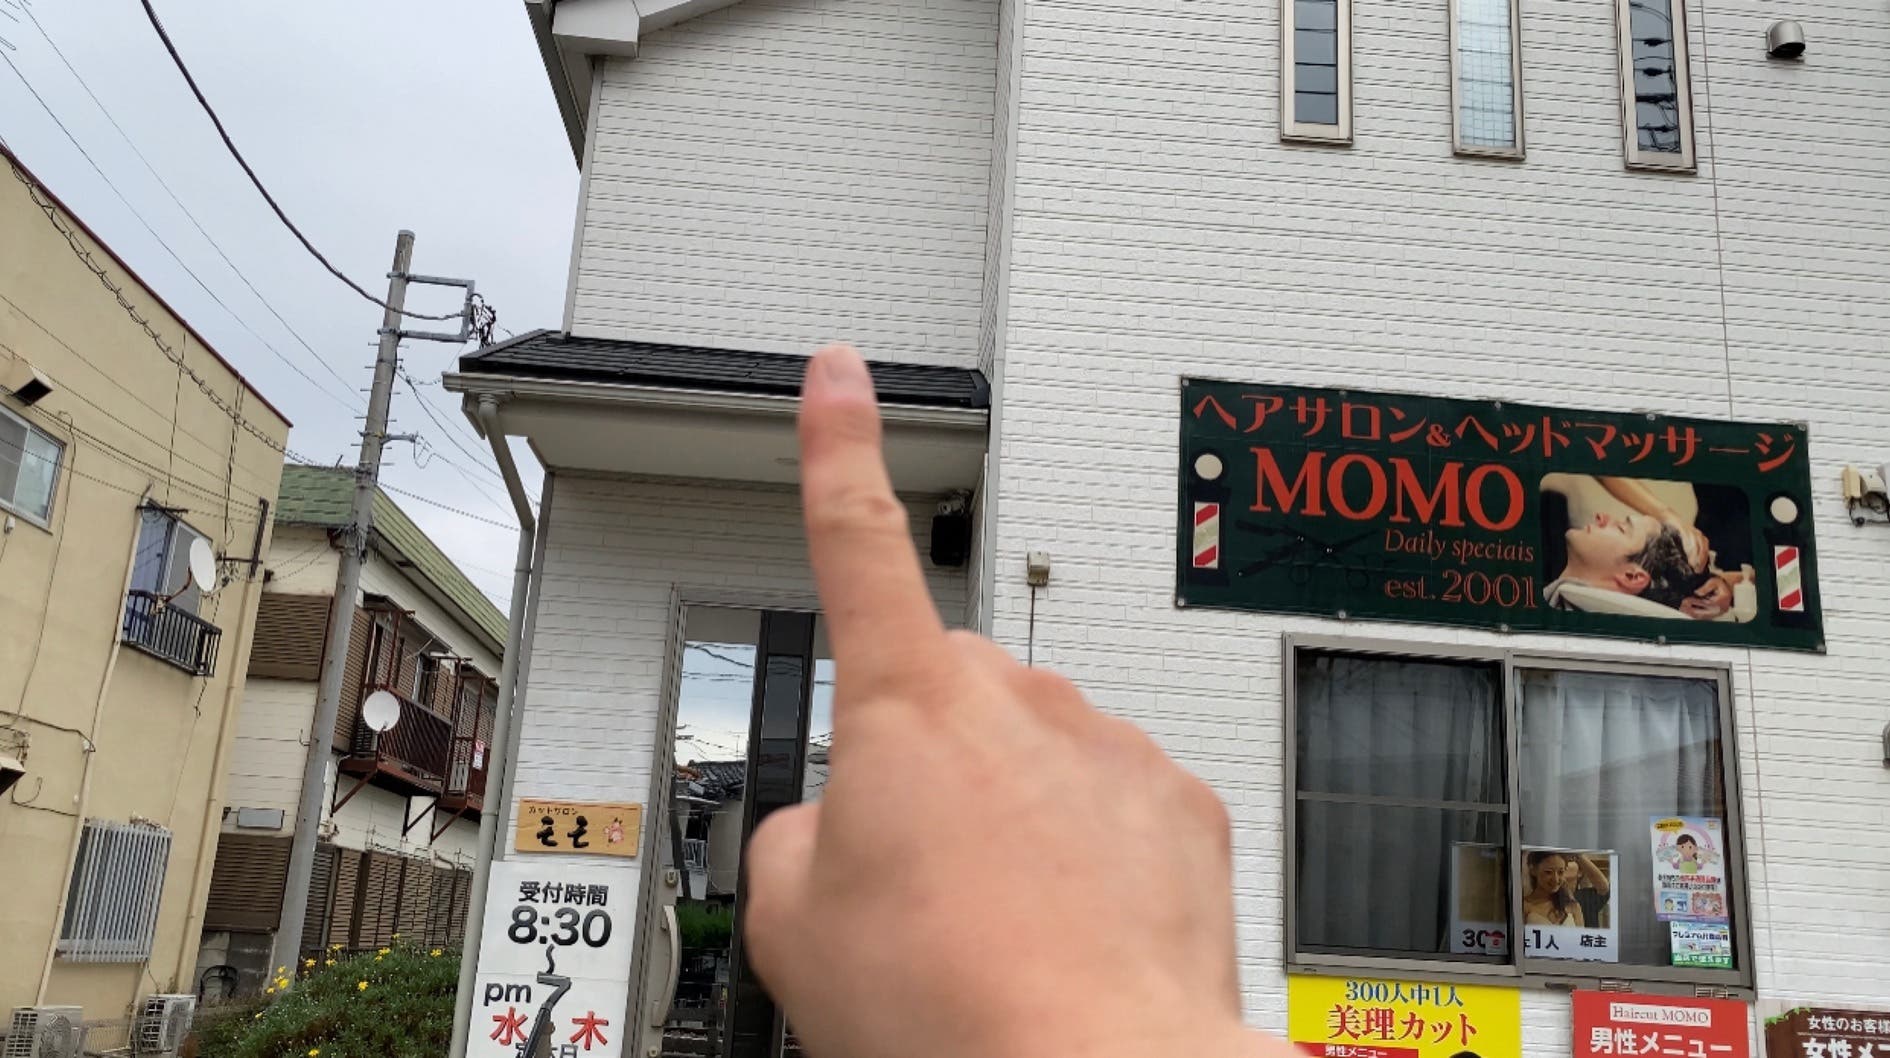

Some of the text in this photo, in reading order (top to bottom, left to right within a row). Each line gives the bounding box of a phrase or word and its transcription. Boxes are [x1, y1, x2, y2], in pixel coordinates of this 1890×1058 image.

[1193, 394, 1796, 473] ヘアサロン&ヘッドマッサージ
[1250, 447, 1525, 531] MOMO
[1385, 528, 1446, 560] Daily
[1385, 569, 1538, 609] est. 2001
[518, 881, 609, 906] 受付時間
[507, 905, 613, 948] 8:30
[1579, 934, 1608, 948] 店主
[483, 971, 572, 1012] pm 7
[1345, 981, 1464, 1007] 300人中1人
[489, 1006, 609, 1051] 水 木
[1327, 1004, 1477, 1046] 美理カット
[1613, 1005, 1709, 1023] Haircut MOMO
[1590, 1027, 1733, 1058] 男性メニュー
